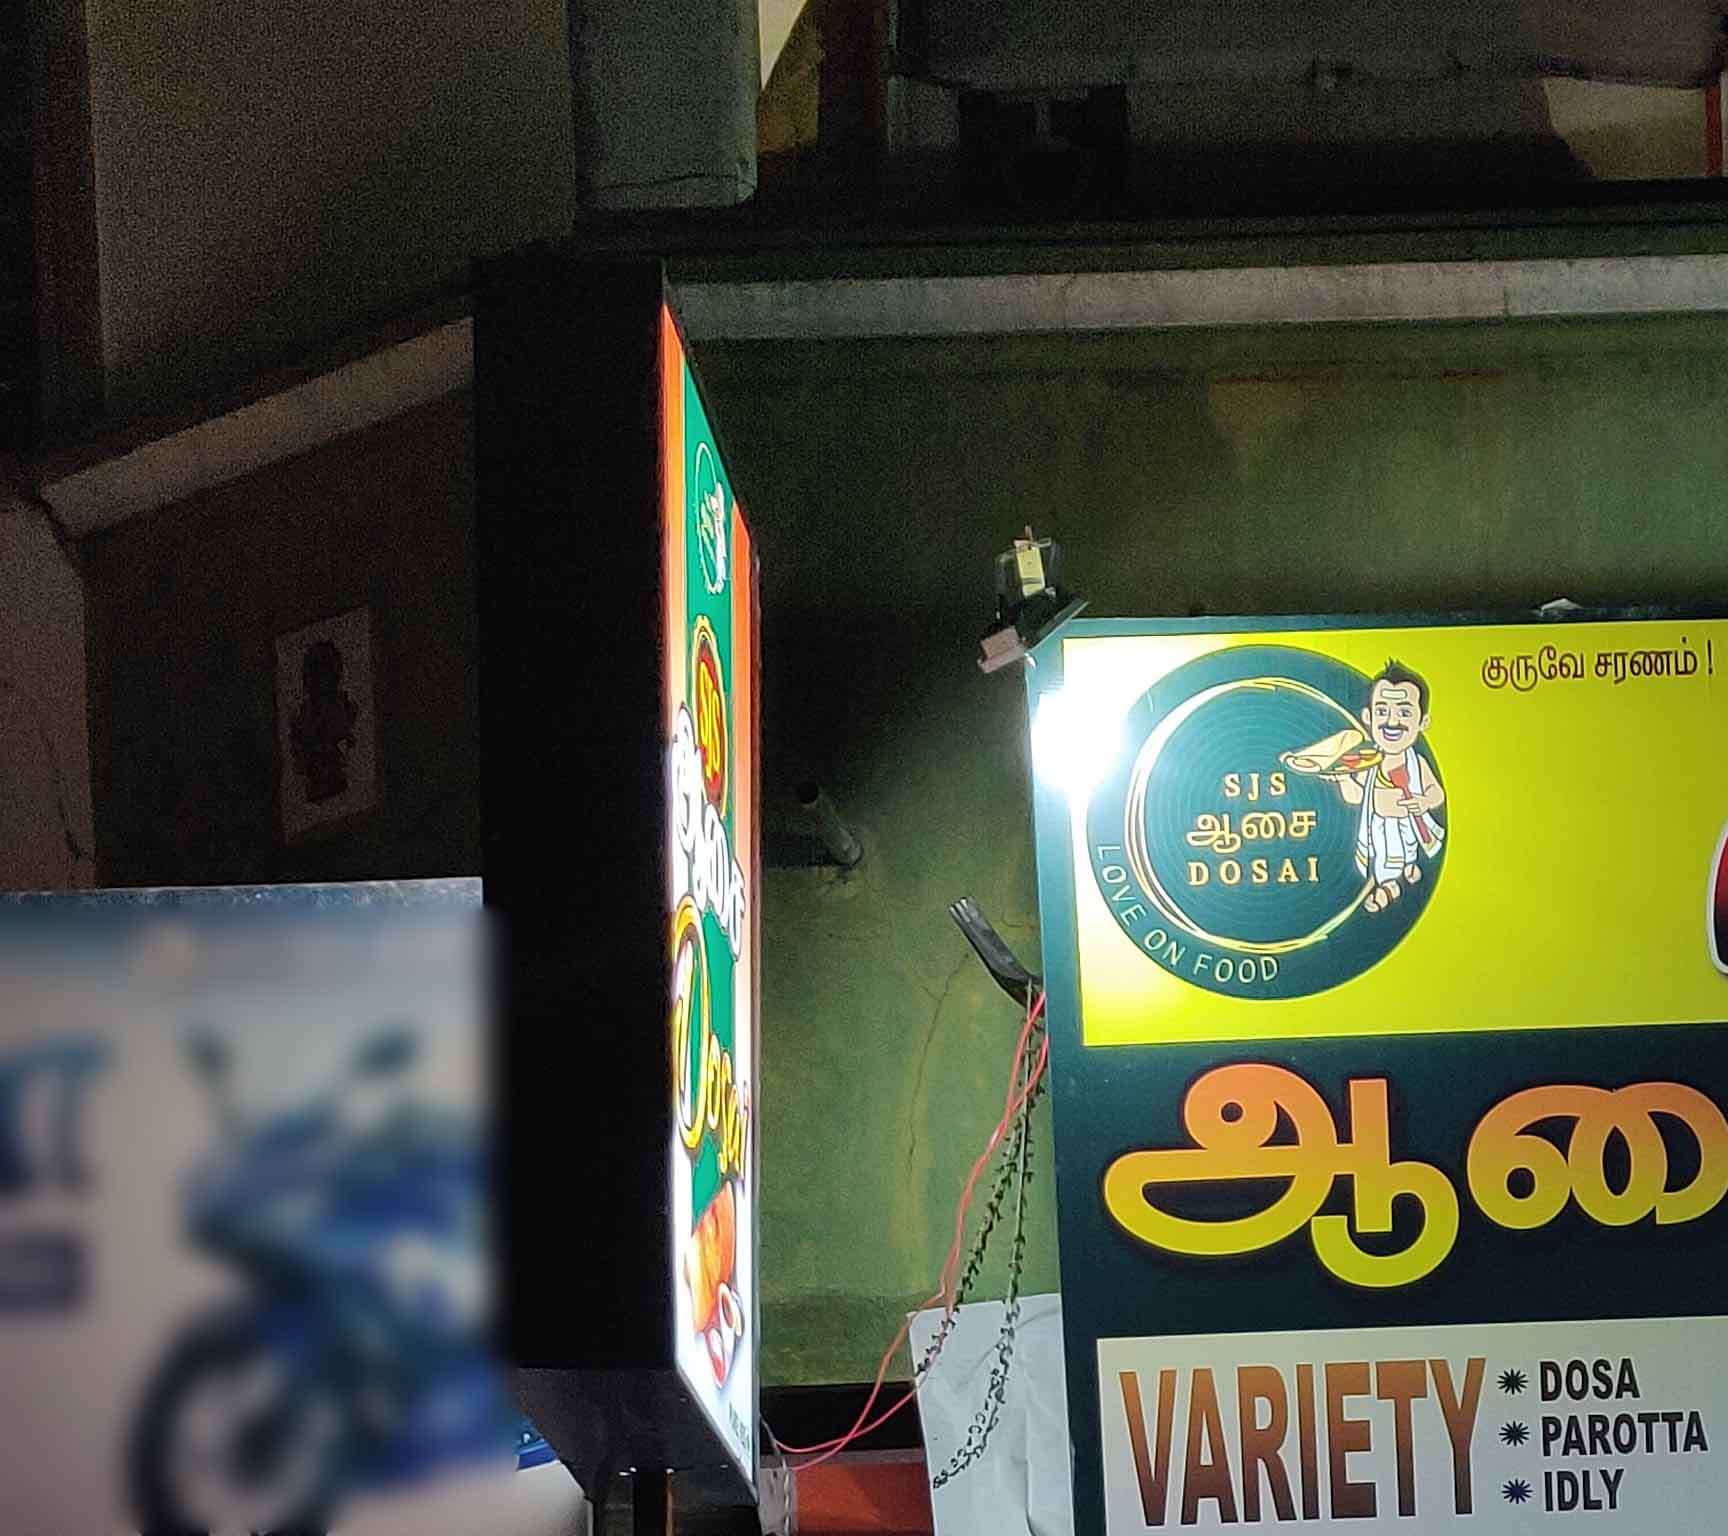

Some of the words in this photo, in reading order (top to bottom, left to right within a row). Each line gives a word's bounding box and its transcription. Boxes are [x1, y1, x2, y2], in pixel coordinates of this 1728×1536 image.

[1482, 644, 1585, 693] குருவே
[1223, 772, 1287, 801] SJS
[1185, 808, 1318, 854] ஆசை
[1186, 856, 1320, 886] DOSAI
[1097, 844, 1147, 927] LOVE
[1143, 928, 1187, 966] ON
[1193, 953, 1279, 984] FOOD
[1539, 1357, 1641, 1402] DOSA
[1119, 1357, 1487, 1528] VARIETY
[1541, 1410, 1709, 1458] PAROTTA
[1544, 1468, 1625, 1513] IDLY
